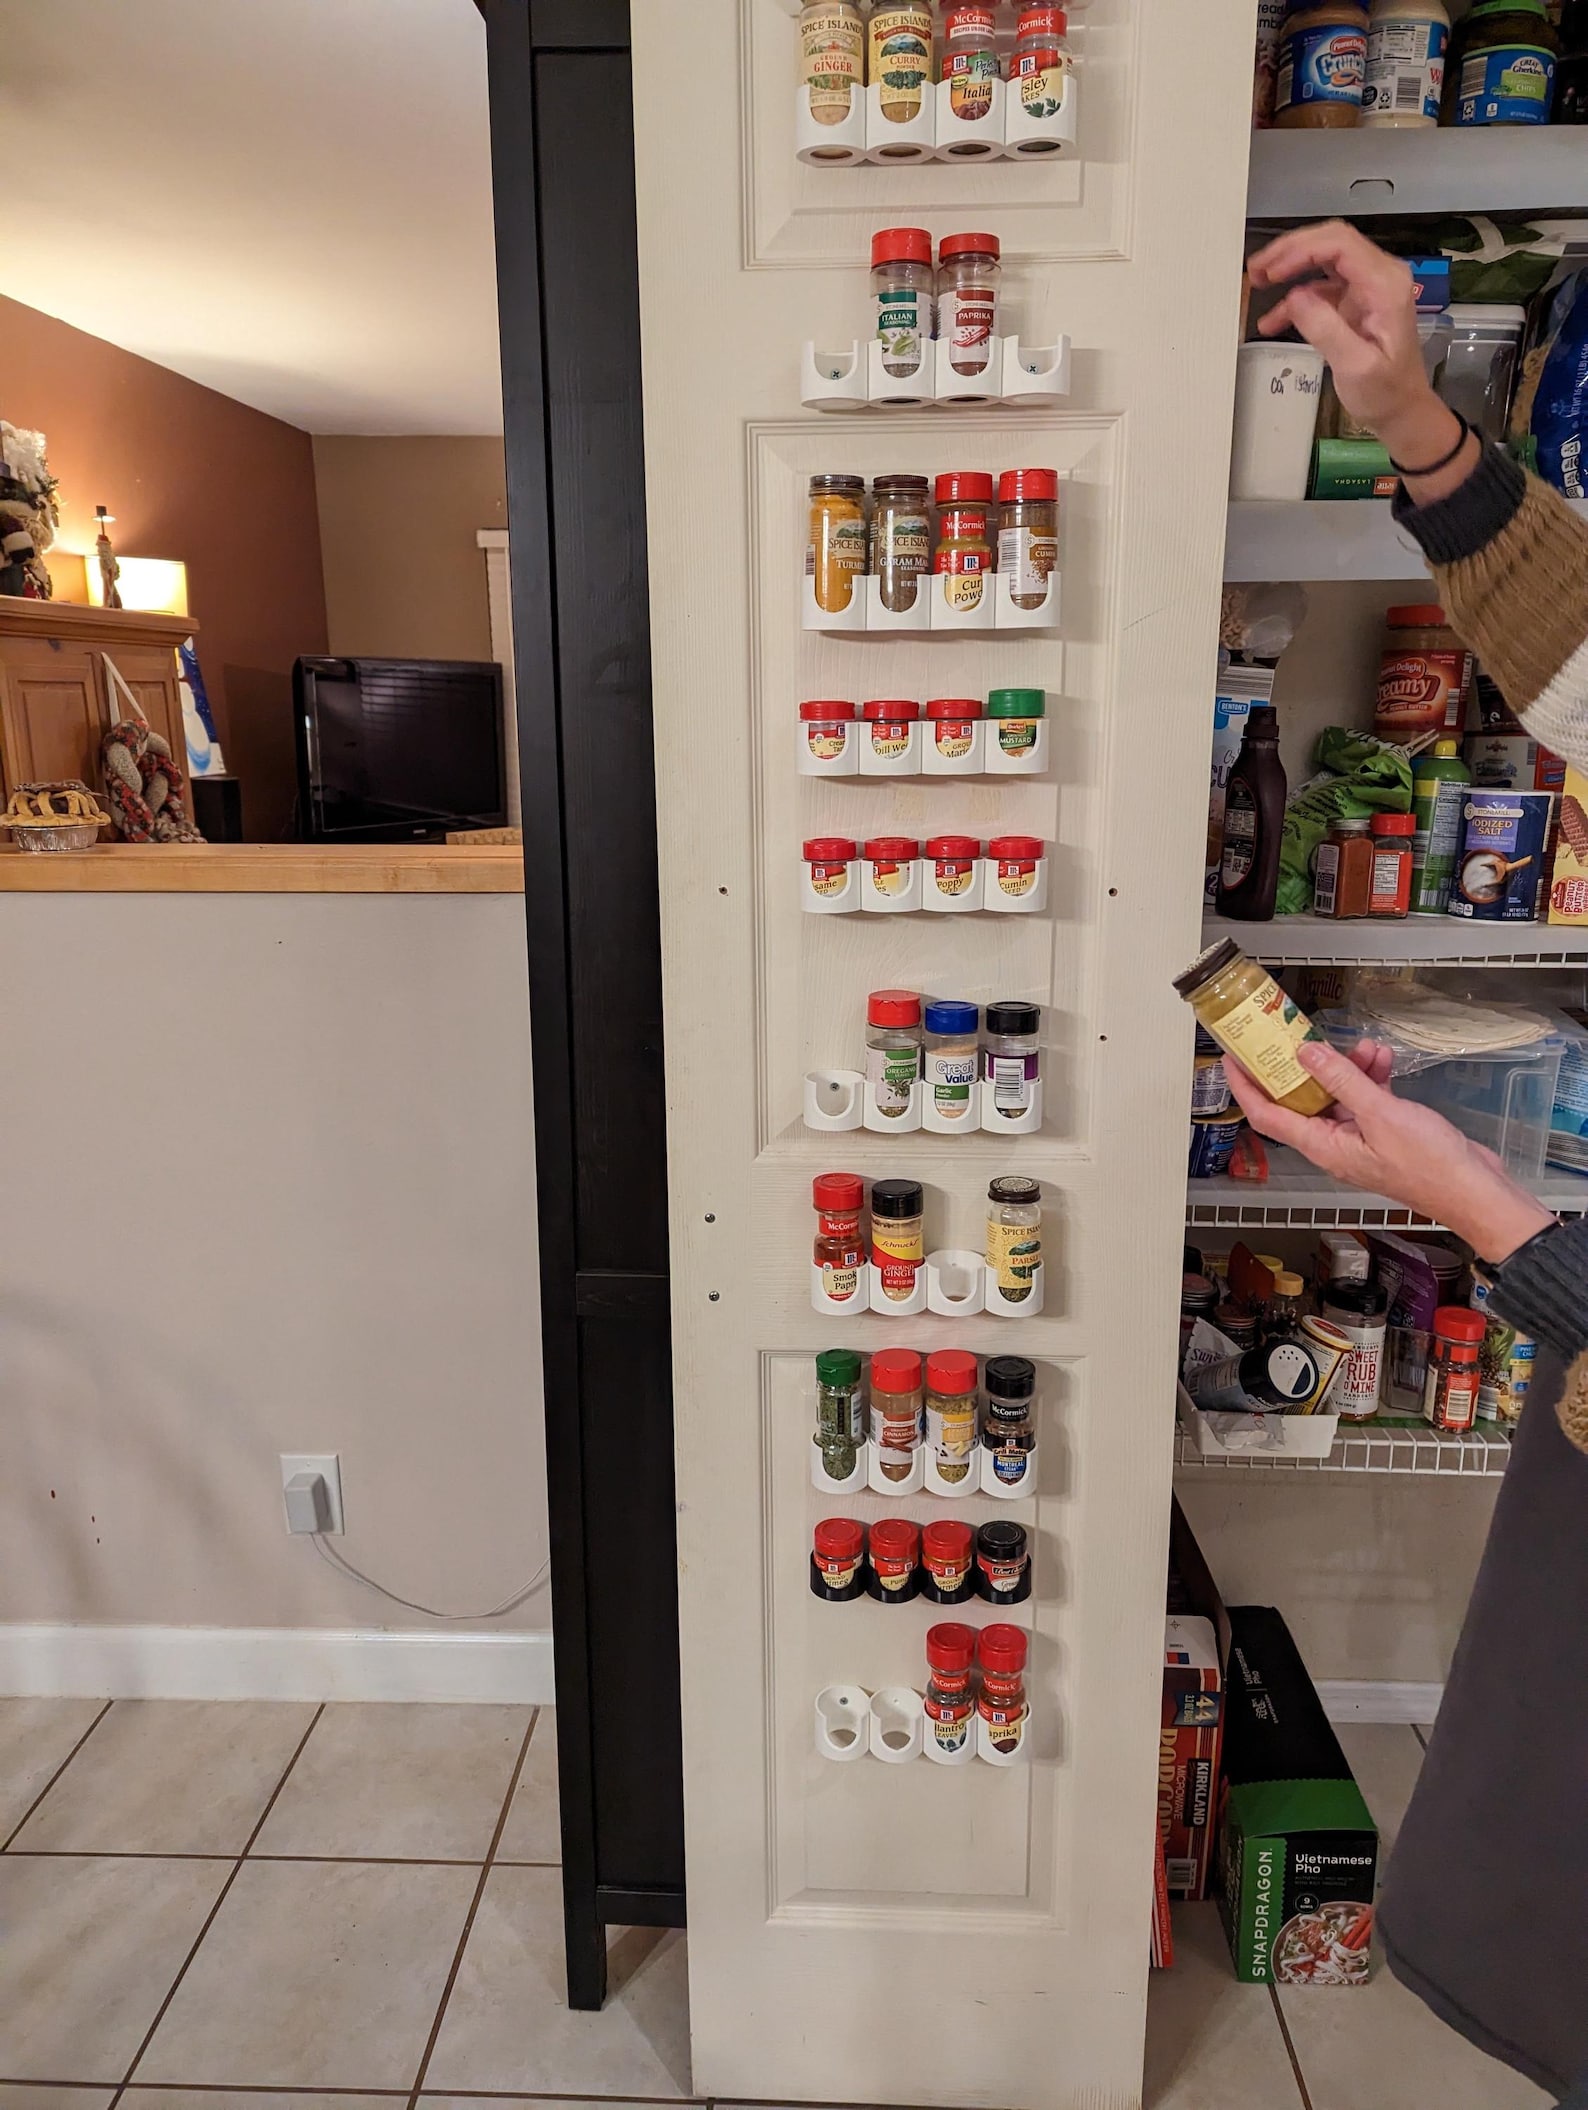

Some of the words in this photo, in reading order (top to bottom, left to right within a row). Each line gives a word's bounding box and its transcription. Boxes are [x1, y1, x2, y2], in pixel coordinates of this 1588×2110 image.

[801, 20, 824, 36] SPICE
[874, 16, 898, 31] SPICE
[890, 56, 921, 65] CURRY
[814, 61, 852, 72] GINGER
[882, 312, 913, 322] ITALIAN
[959, 312, 991, 320] PAPRIKA
[829, 538, 852, 549] SPICE
[1472, 819, 1513, 829] IODIZED
[1478, 827, 1503, 835] SALT
[1000, 879, 1028, 890] Cumin
[936, 1060, 974, 1075] Great
[945, 1074, 974, 1084] Value
[1002, 1226, 1026, 1236] SPICE
[1347, 1351, 1379, 1363] SWEET
[1347, 1363, 1376, 1381] RUB
[1173, 1765, 1187, 1820] MICROWAVE
[1192, 1761, 1209, 1826] KIRKLAND
[1295, 1854, 1373, 1865] Vietnamese
[1295, 1864, 1321, 1874] Pho
[1303, 1897, 1311, 1905] 9
